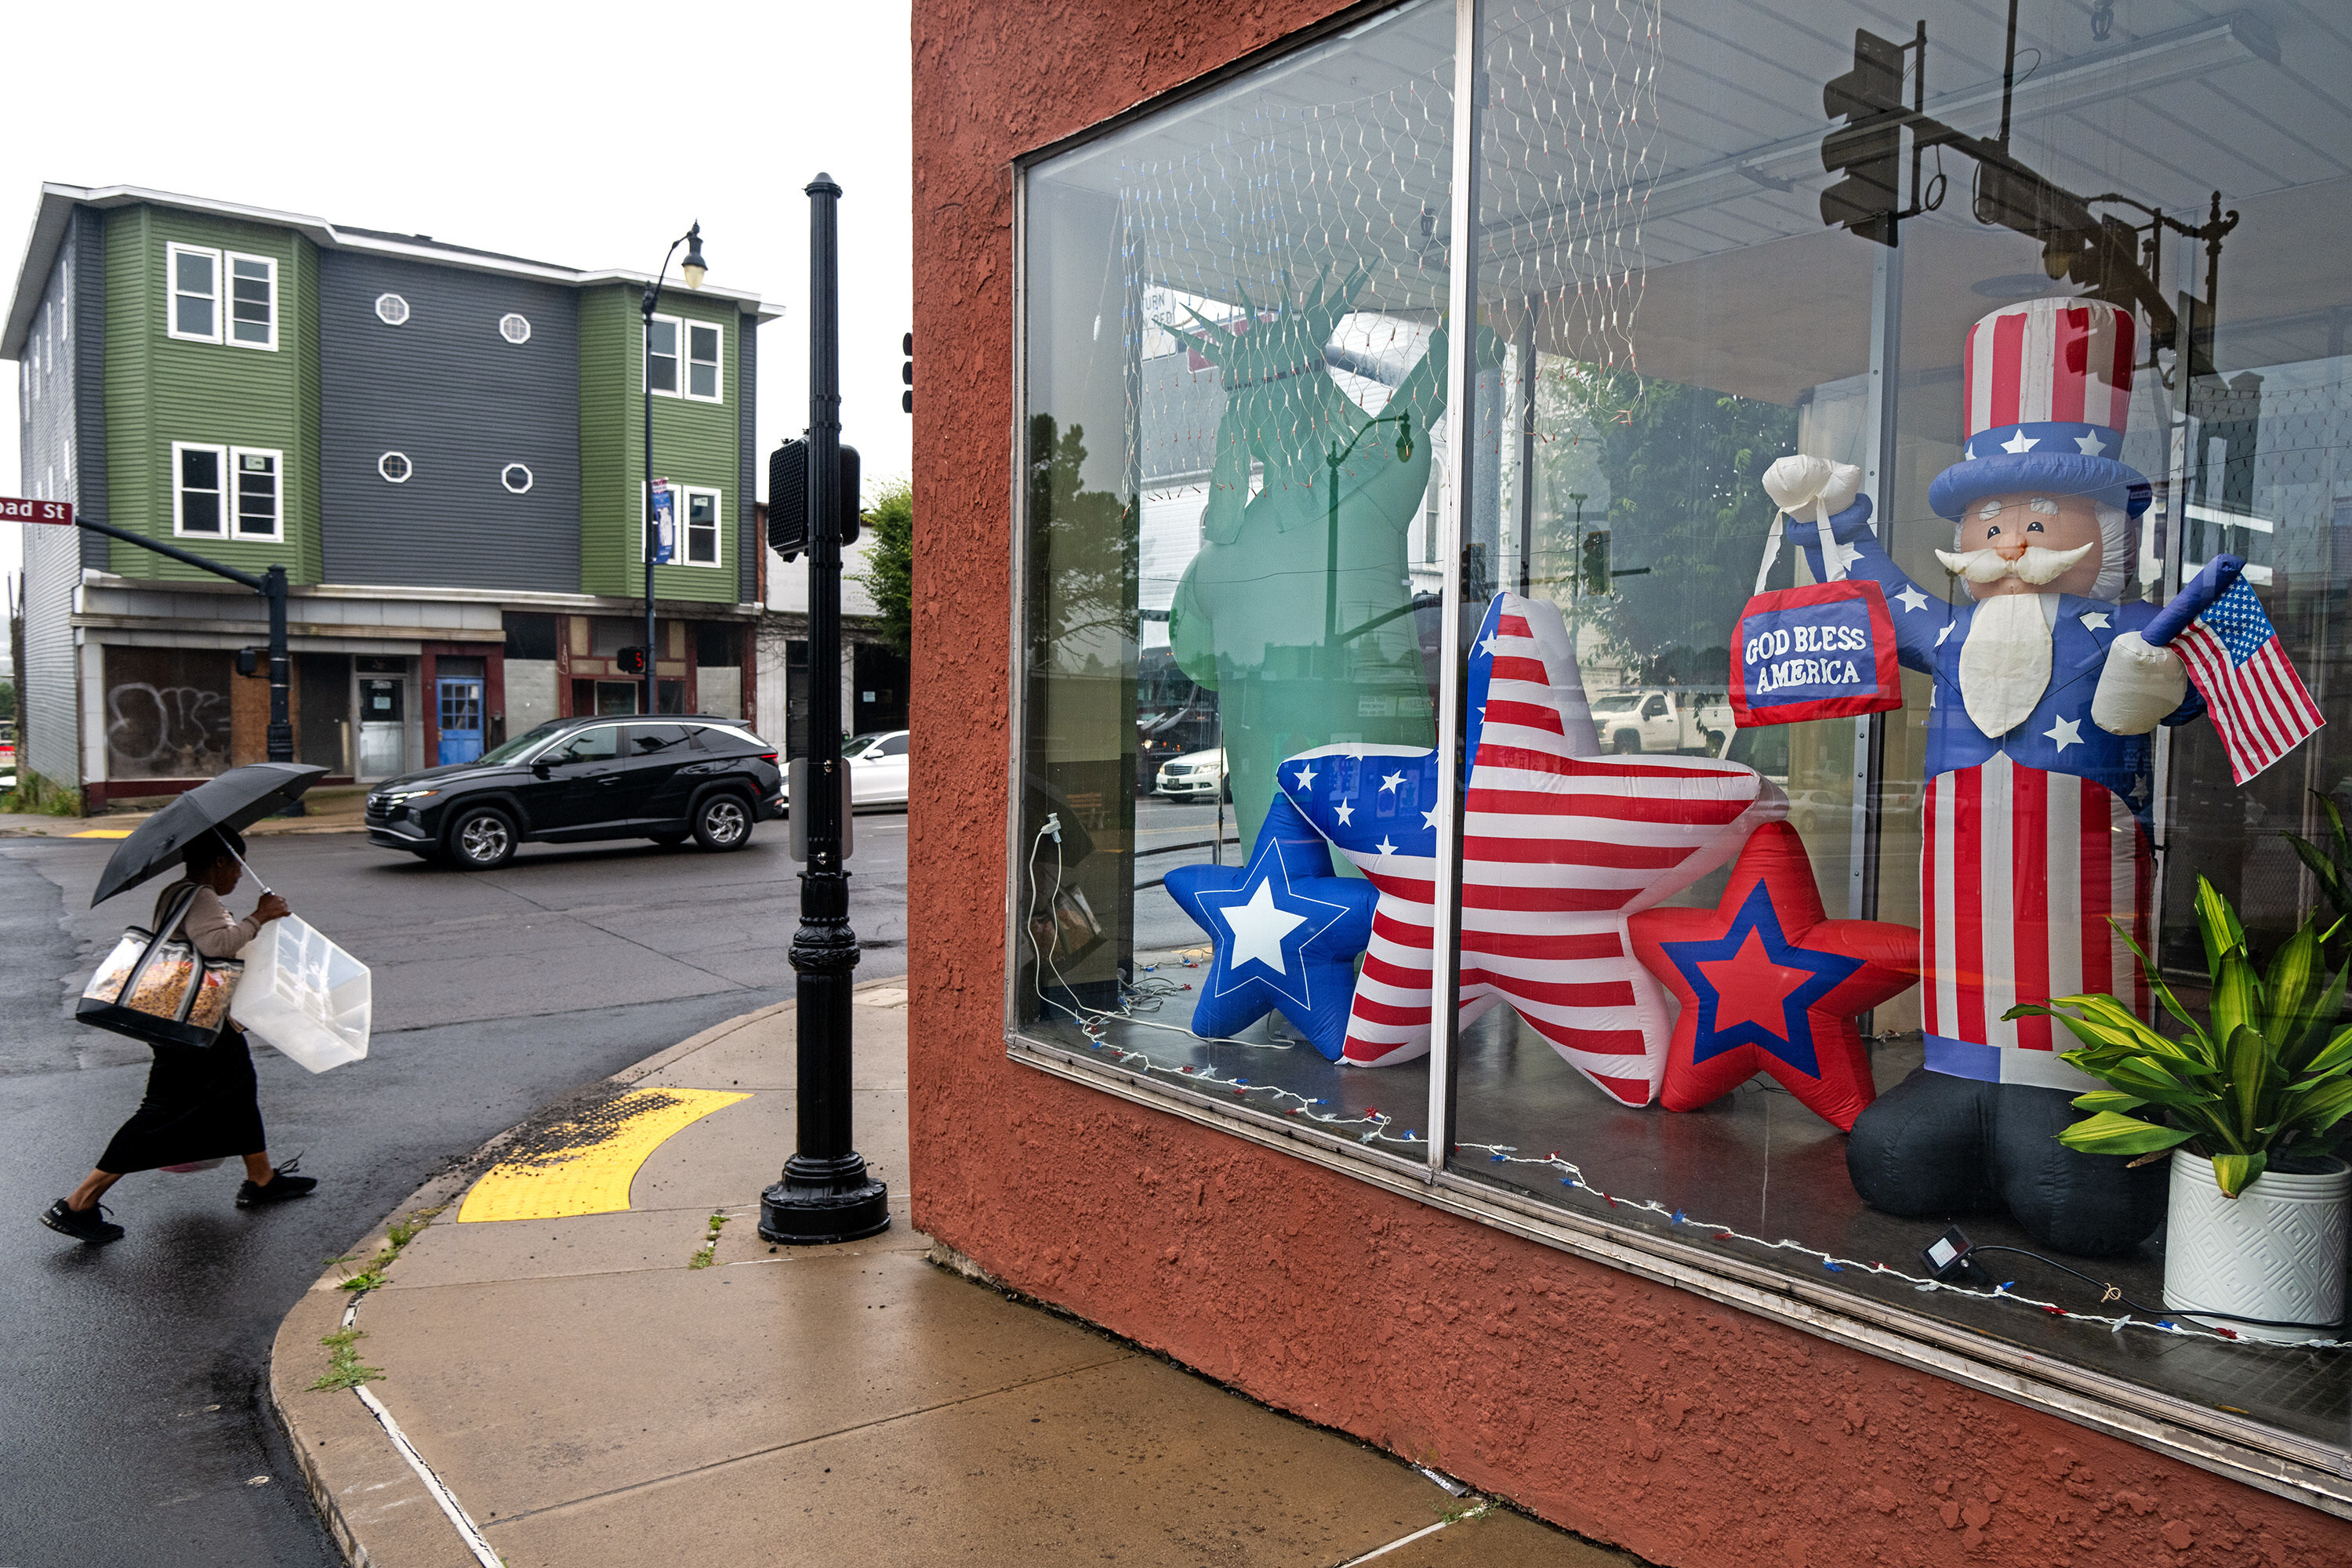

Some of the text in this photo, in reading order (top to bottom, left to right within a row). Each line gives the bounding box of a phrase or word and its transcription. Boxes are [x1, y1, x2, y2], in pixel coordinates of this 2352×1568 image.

[42, 503, 64, 519] St
[1745, 626, 1867, 665] GOD BLESS
[636, 652, 643, 667] 5
[1756, 658, 1860, 695] AMERICA
